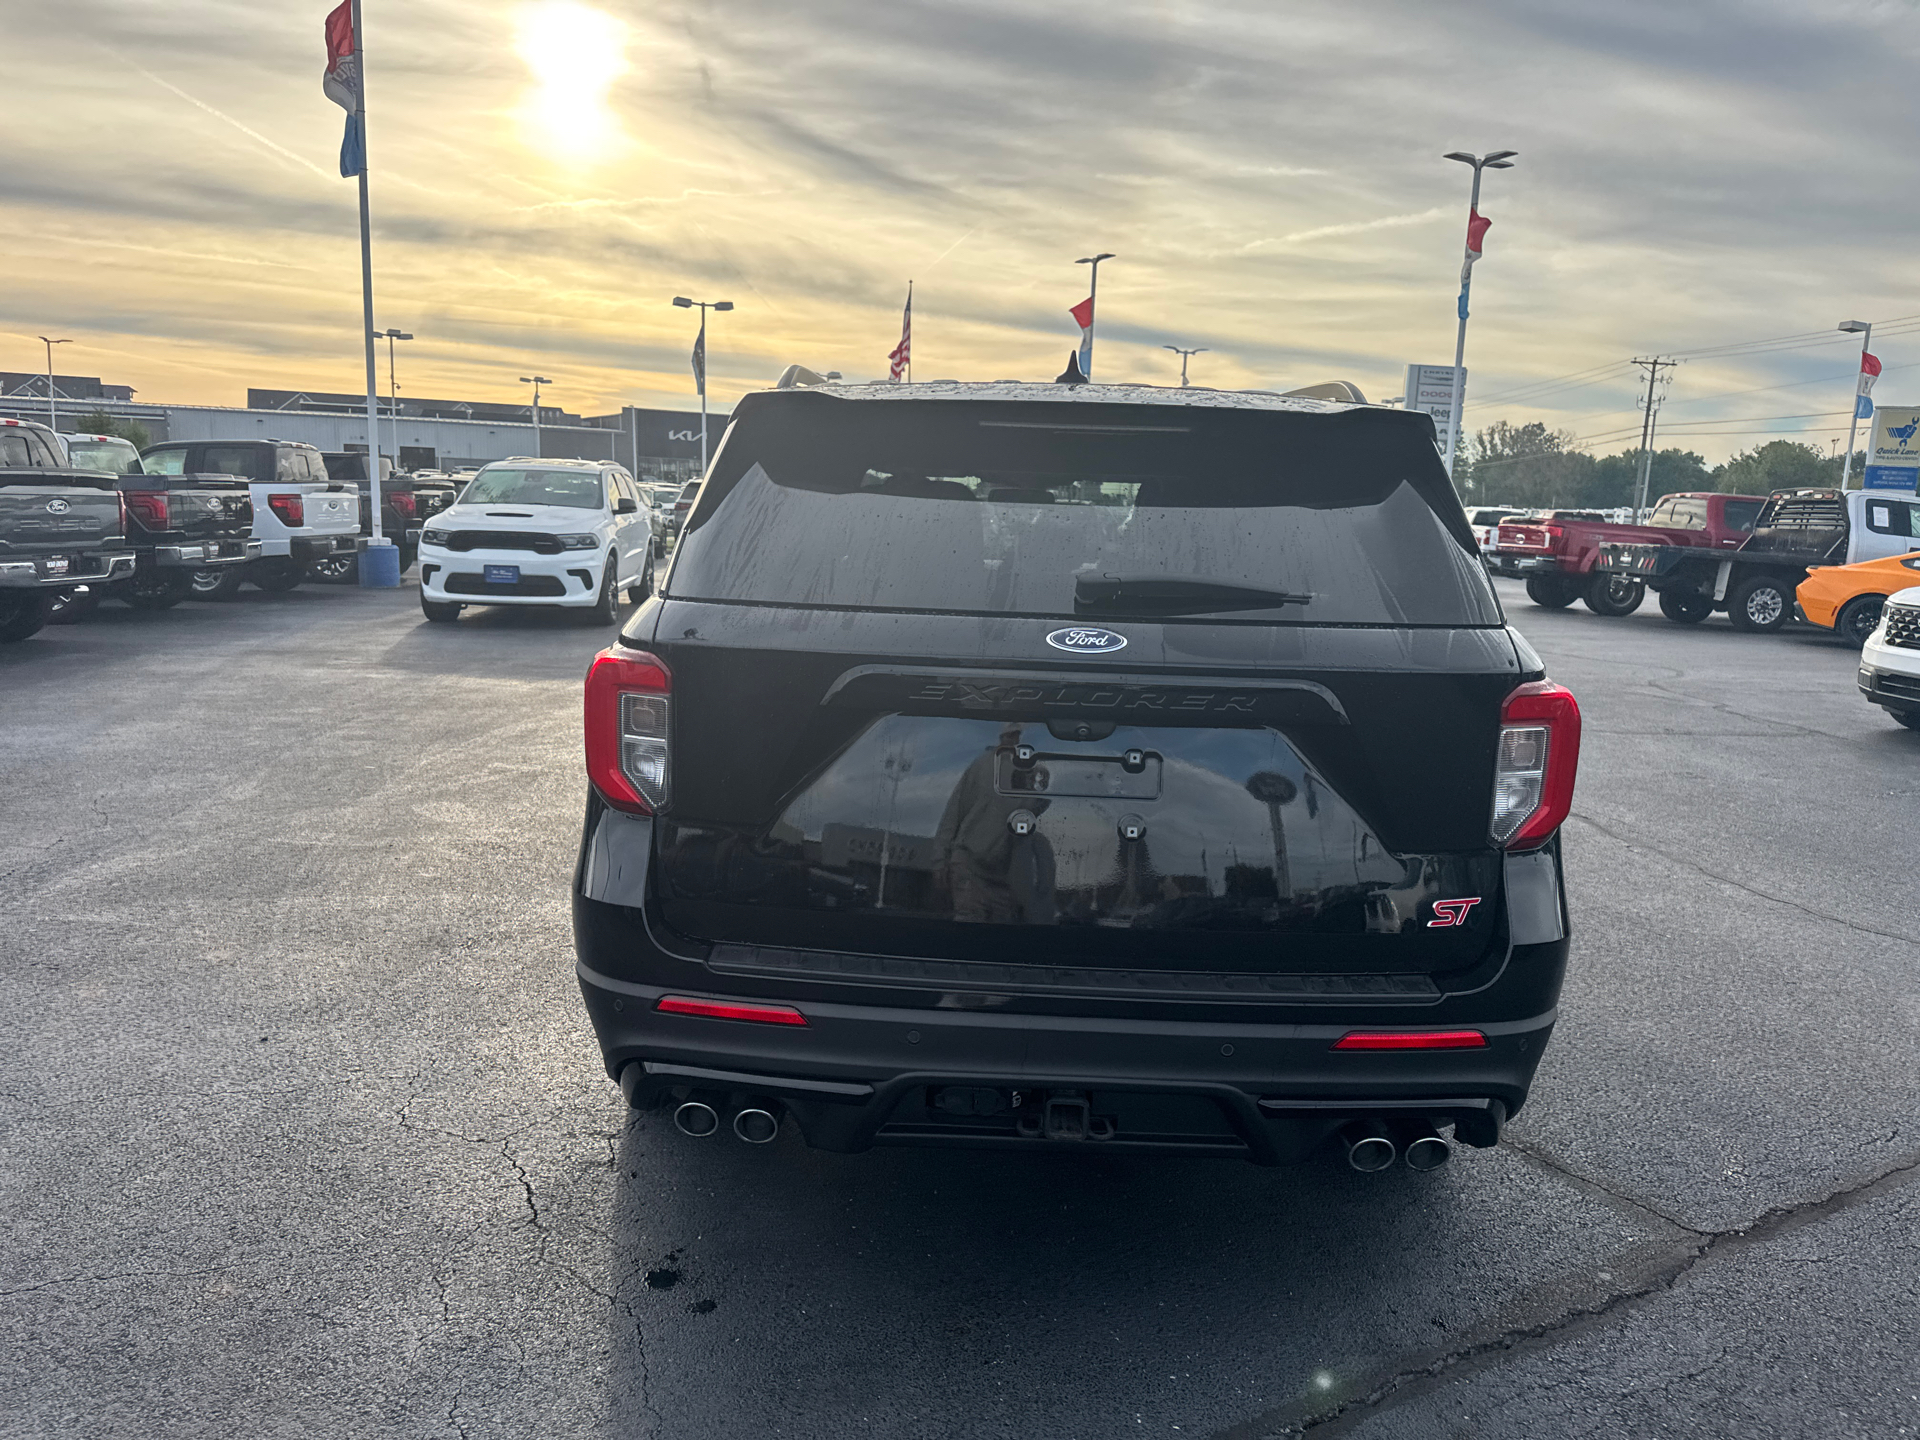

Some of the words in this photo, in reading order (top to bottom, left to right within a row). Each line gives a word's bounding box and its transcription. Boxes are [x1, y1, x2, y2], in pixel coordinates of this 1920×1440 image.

[1876, 447, 1900, 455] Quick
[1065, 630, 1109, 646] Ford
[909, 684, 1259, 712] EXPLORER
[1426, 897, 1482, 927] ST
